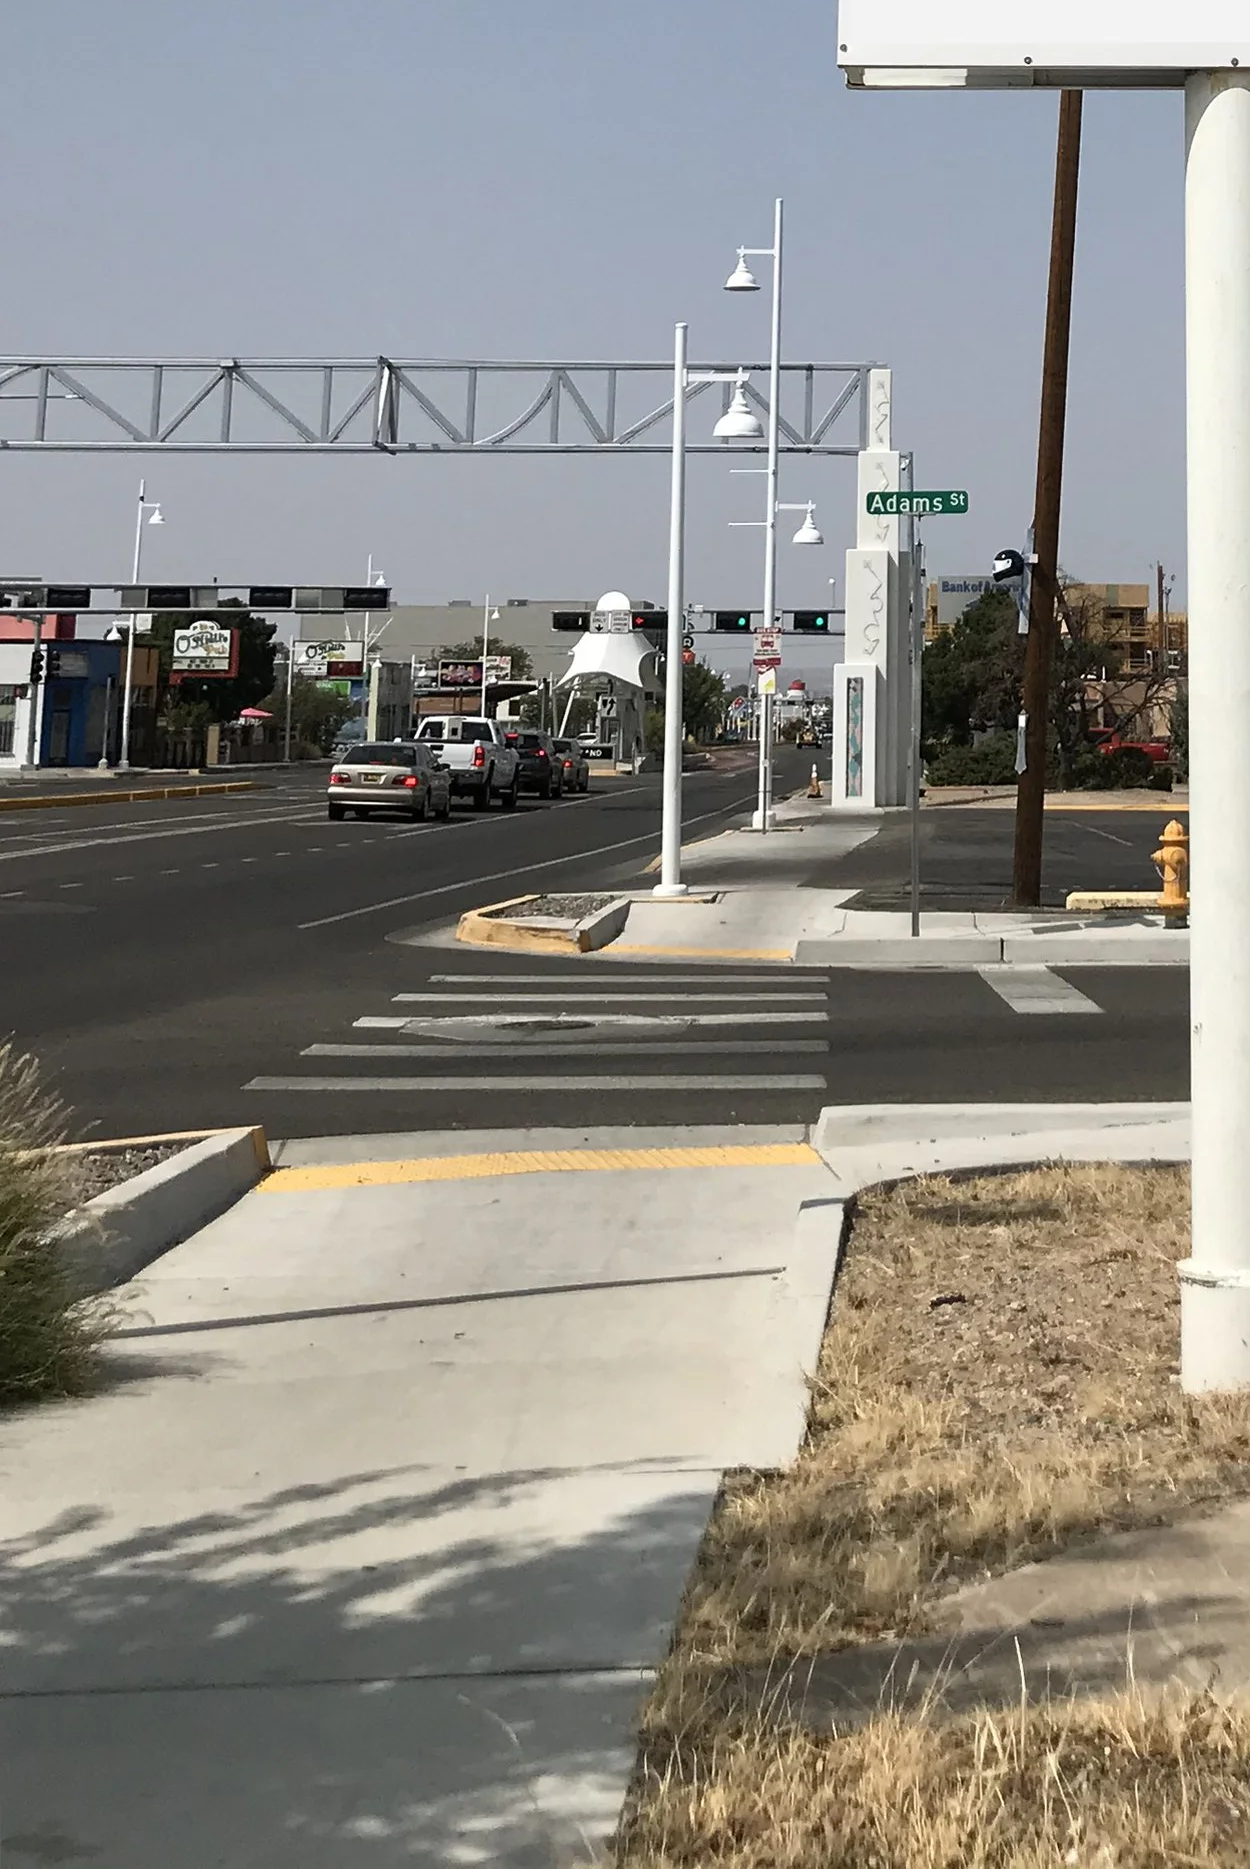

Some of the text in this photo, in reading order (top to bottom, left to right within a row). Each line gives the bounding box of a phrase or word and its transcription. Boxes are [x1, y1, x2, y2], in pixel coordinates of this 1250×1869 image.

[870, 493, 965, 512] Adams St
[942, 580, 970, 592] Bank
